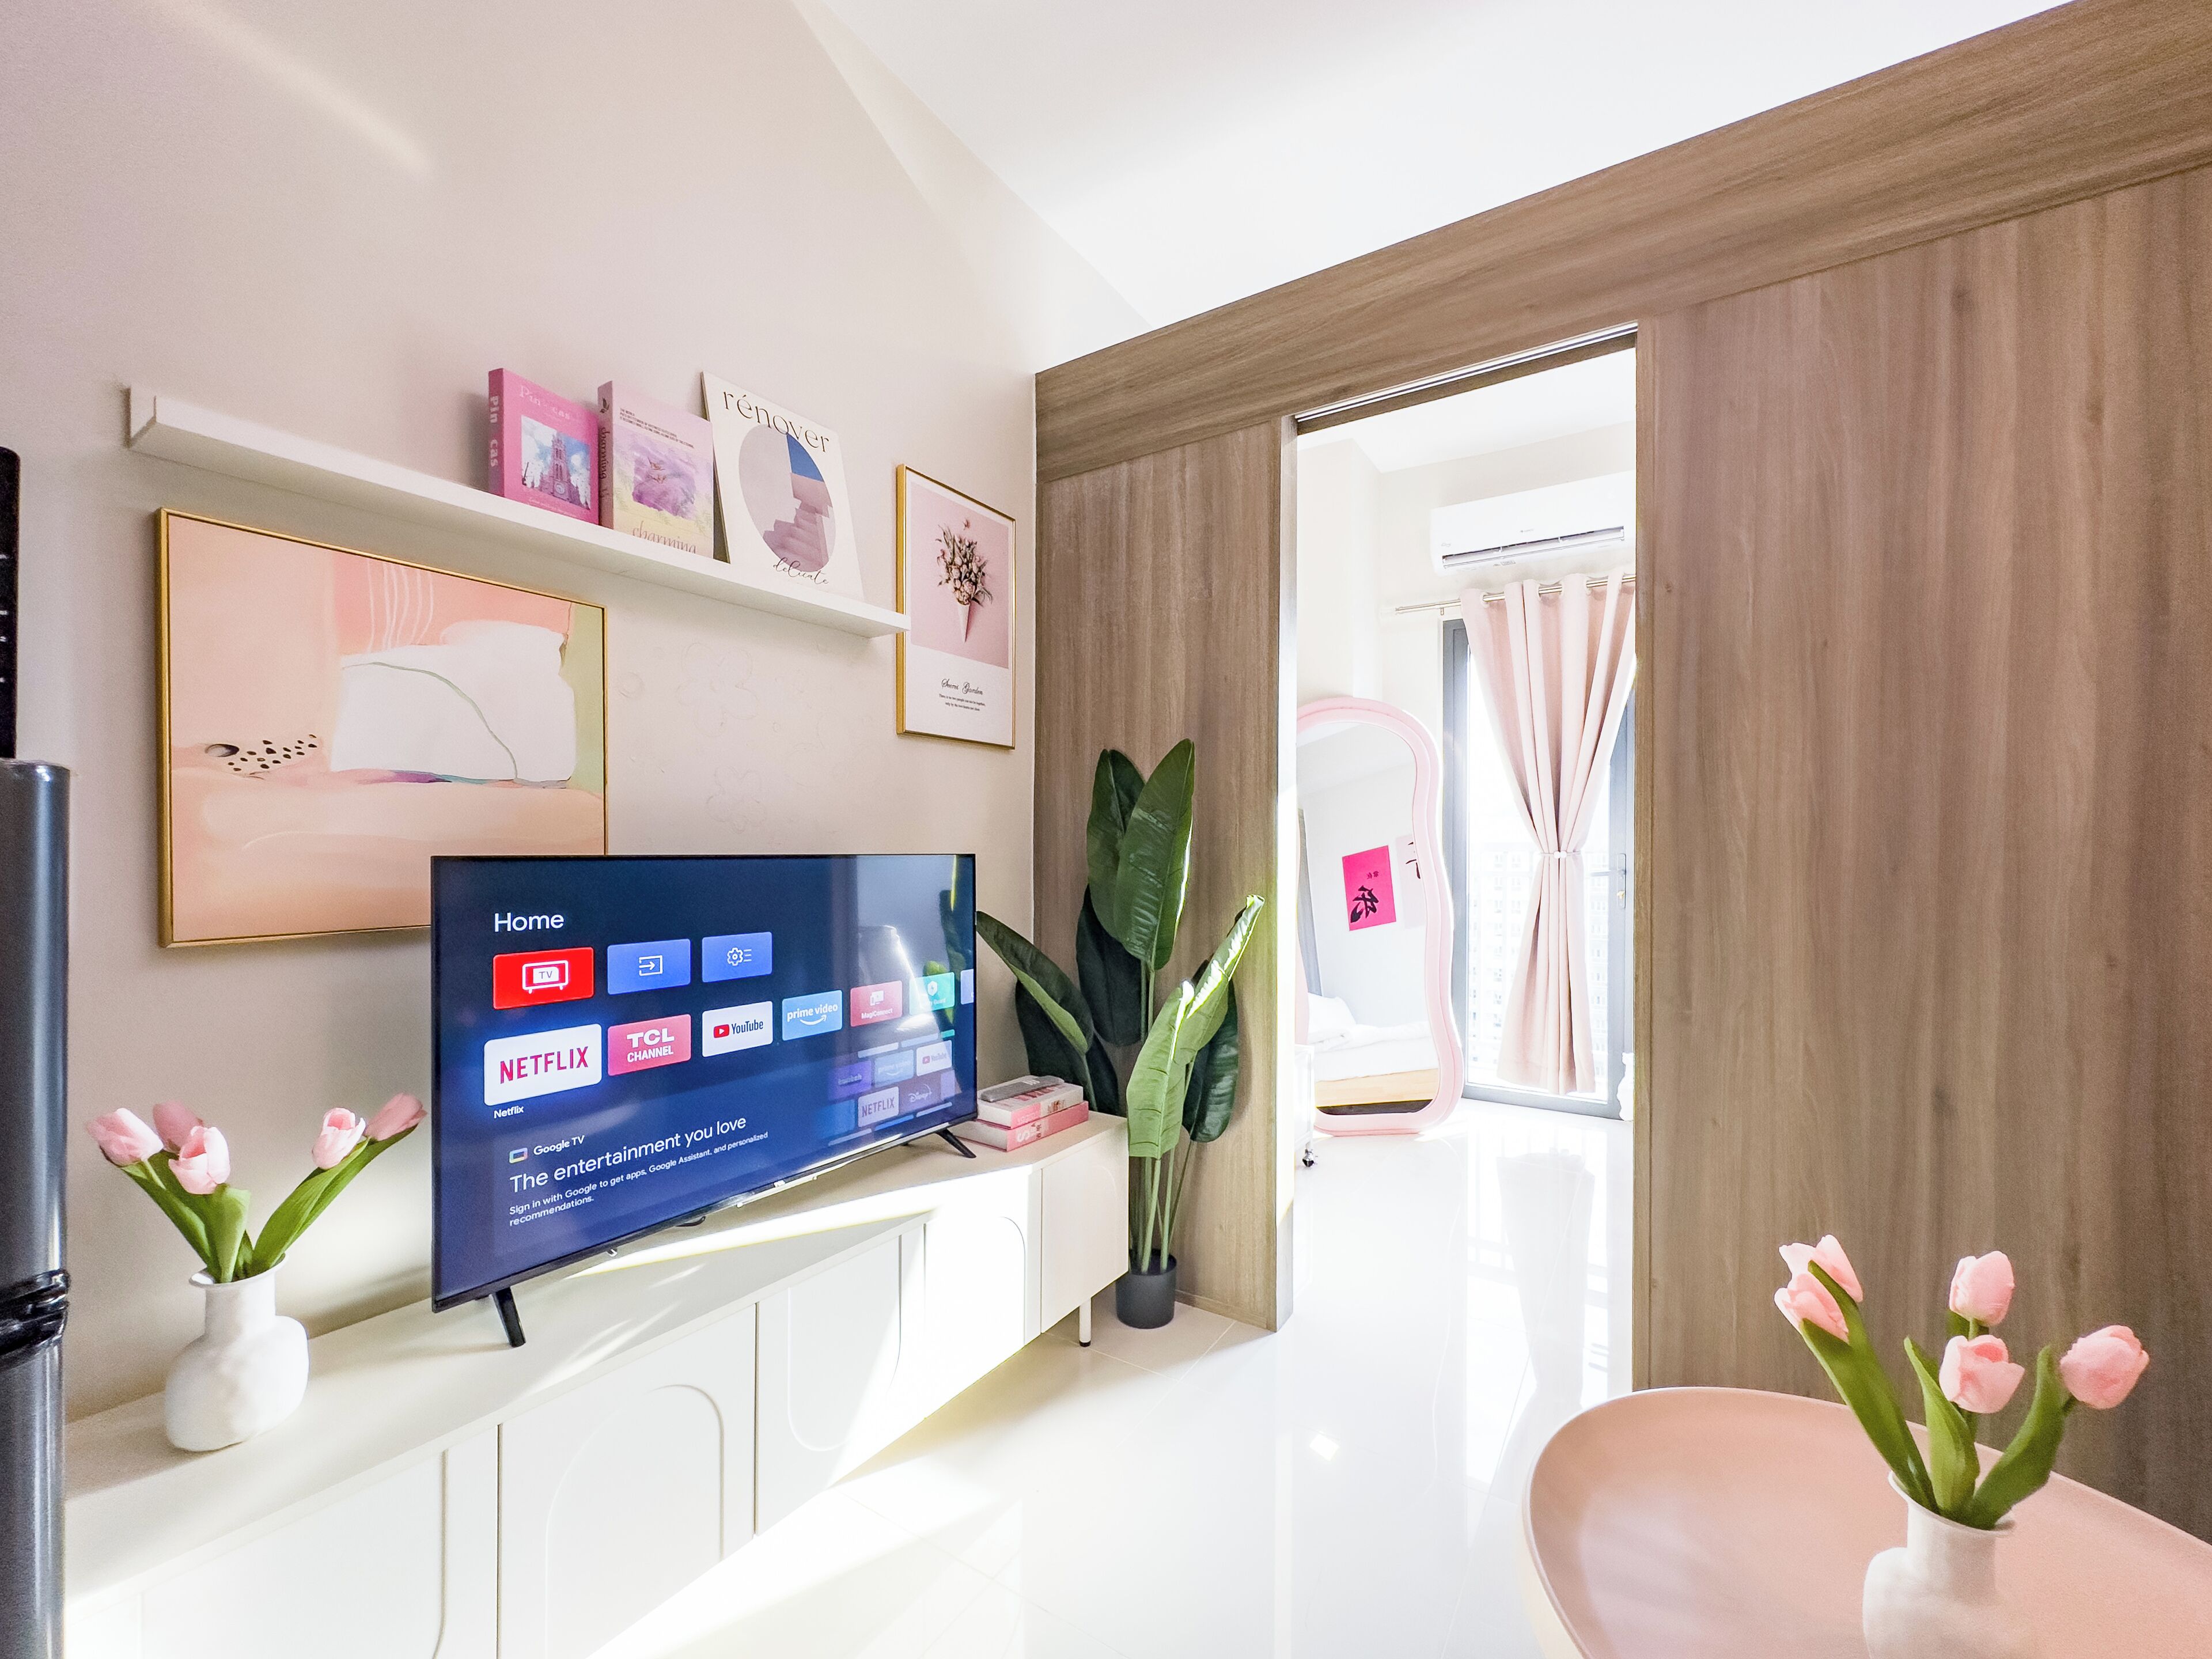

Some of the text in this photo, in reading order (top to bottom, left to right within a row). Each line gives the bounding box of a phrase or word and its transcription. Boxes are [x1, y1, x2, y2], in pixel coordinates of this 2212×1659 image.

[723, 391, 830, 452] rénover
[772, 557, 829, 585] delicate
[494, 912, 564, 932] Home
[538, 970, 553, 979] TV
[787, 1003, 838, 1022] prime video
[626, 1027, 675, 1048] TCL
[731, 1019, 764, 1035] YouTube
[627, 1045, 674, 1063] CHANNEL
[500, 1046, 589, 1084] NETFLIX
[494, 1105, 524, 1119] Netflix
[862, 1097, 895, 1118] NETFLIX
[509, 1118, 747, 1193] The entertainment you love
[533, 1135, 585, 1156] Google TV
[509, 1203, 530, 1215] Sign
[532, 1200, 541, 1209] in
[543, 1193, 563, 1205] with
[565, 1184, 597, 1198] Google
[599, 1180, 608, 1188] to
[610, 1175, 624, 1187] get
[649, 1159, 677, 1173] Google
[713, 1144, 726, 1154] and
[727, 1131, 768, 1151] personalized
[509, 1195, 594, 1226] recommendations.
